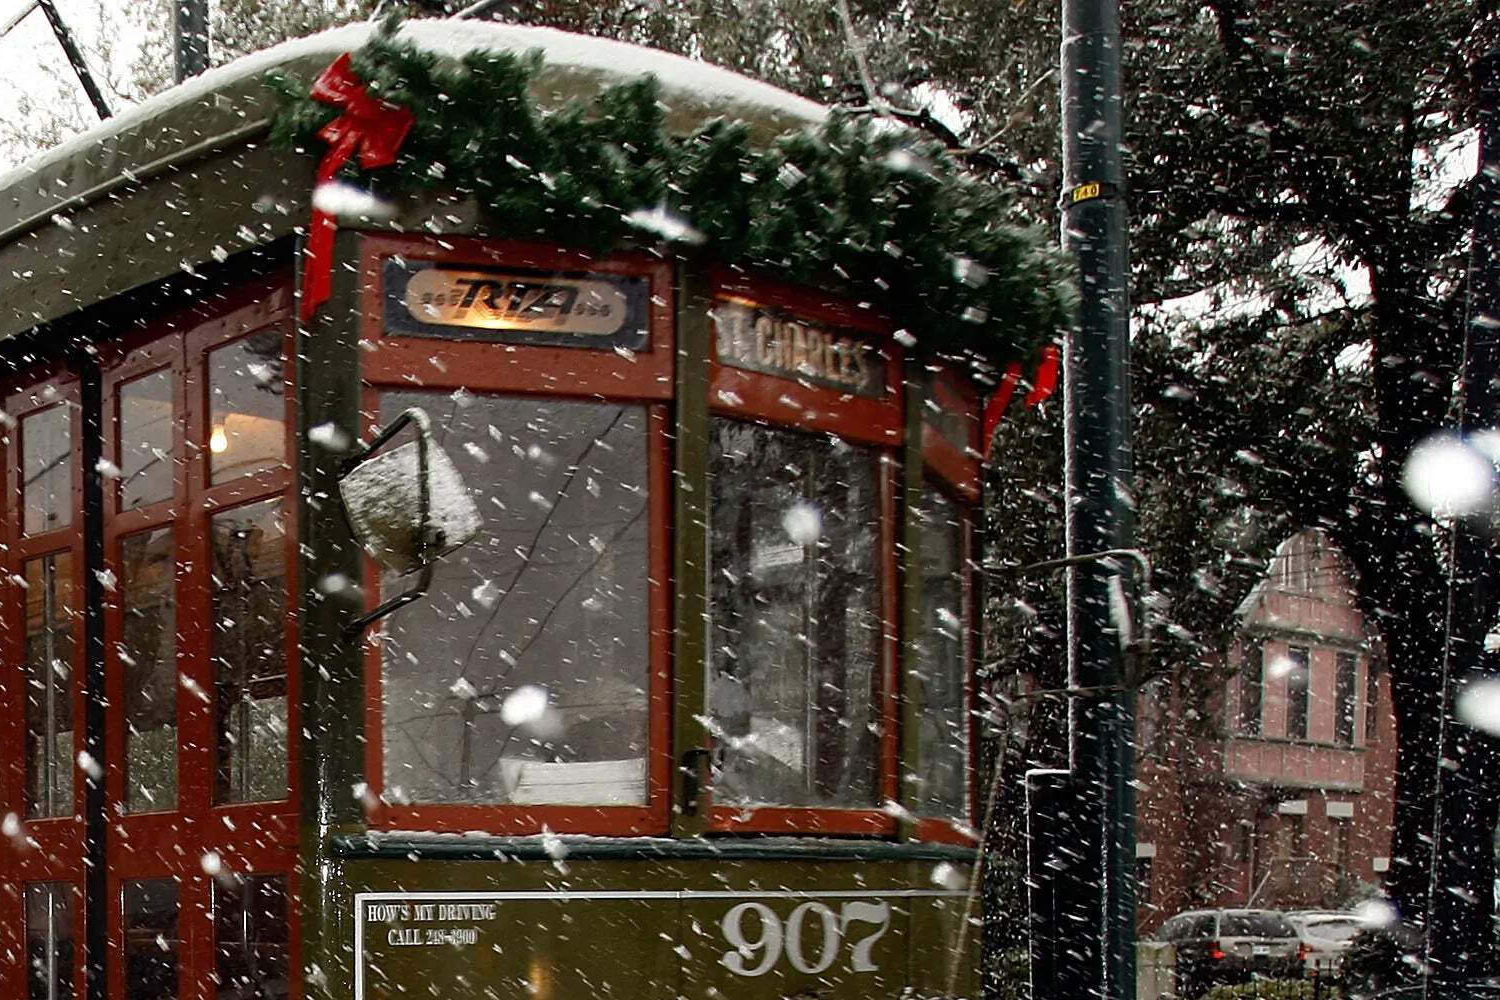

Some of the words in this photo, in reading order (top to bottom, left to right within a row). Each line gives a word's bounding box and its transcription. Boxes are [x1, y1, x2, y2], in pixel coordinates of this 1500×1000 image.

[451, 277, 579, 325] RTA
[755, 315, 871, 388] CHARLES
[367, 904, 410, 922] HOW'S
[414, 904, 436, 920] MY
[438, 904, 496, 921] DRIVING
[387, 928, 423, 945] CALL
[720, 901, 890, 977] 907
